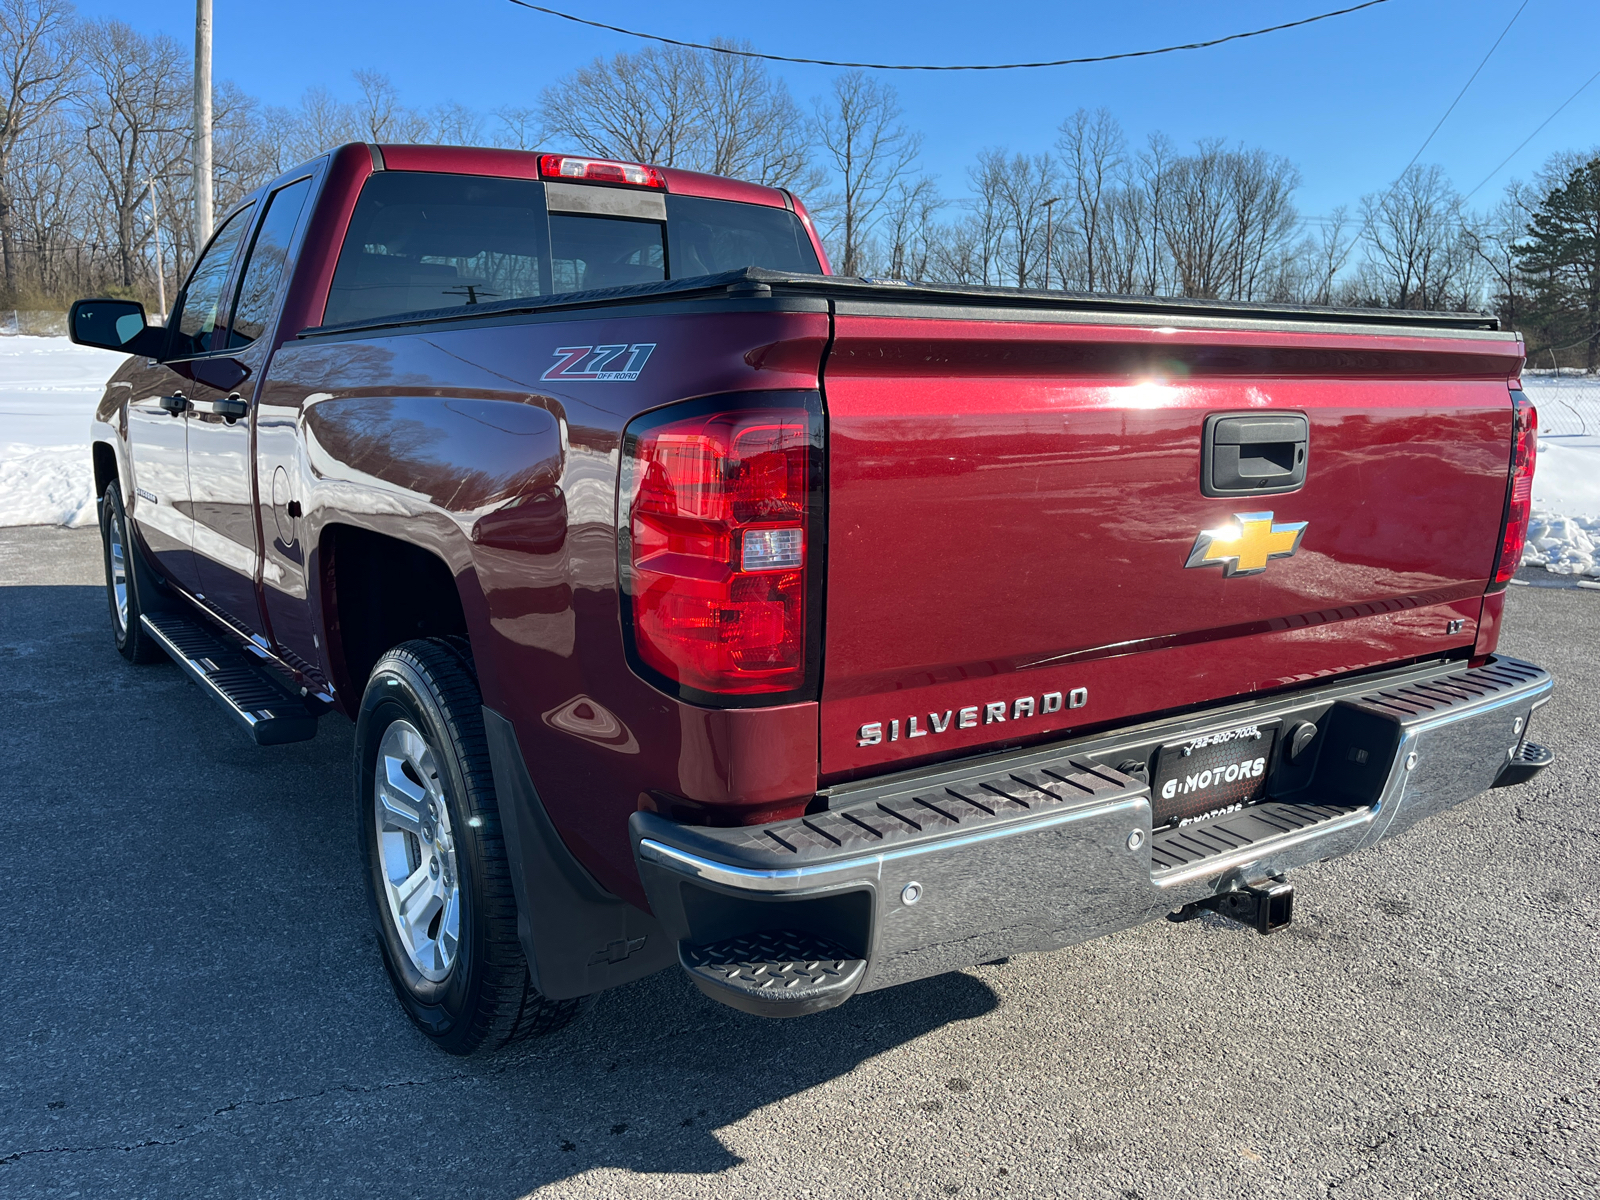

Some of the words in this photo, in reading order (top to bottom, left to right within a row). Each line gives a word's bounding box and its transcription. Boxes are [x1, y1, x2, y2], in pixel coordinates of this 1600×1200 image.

[540, 343, 657, 381] Z71
[597, 372, 614, 380] OFF
[614, 372, 638, 380] ROAD
[1447, 618, 1465, 635] LT
[857, 686, 1088, 747] SILVERADO
